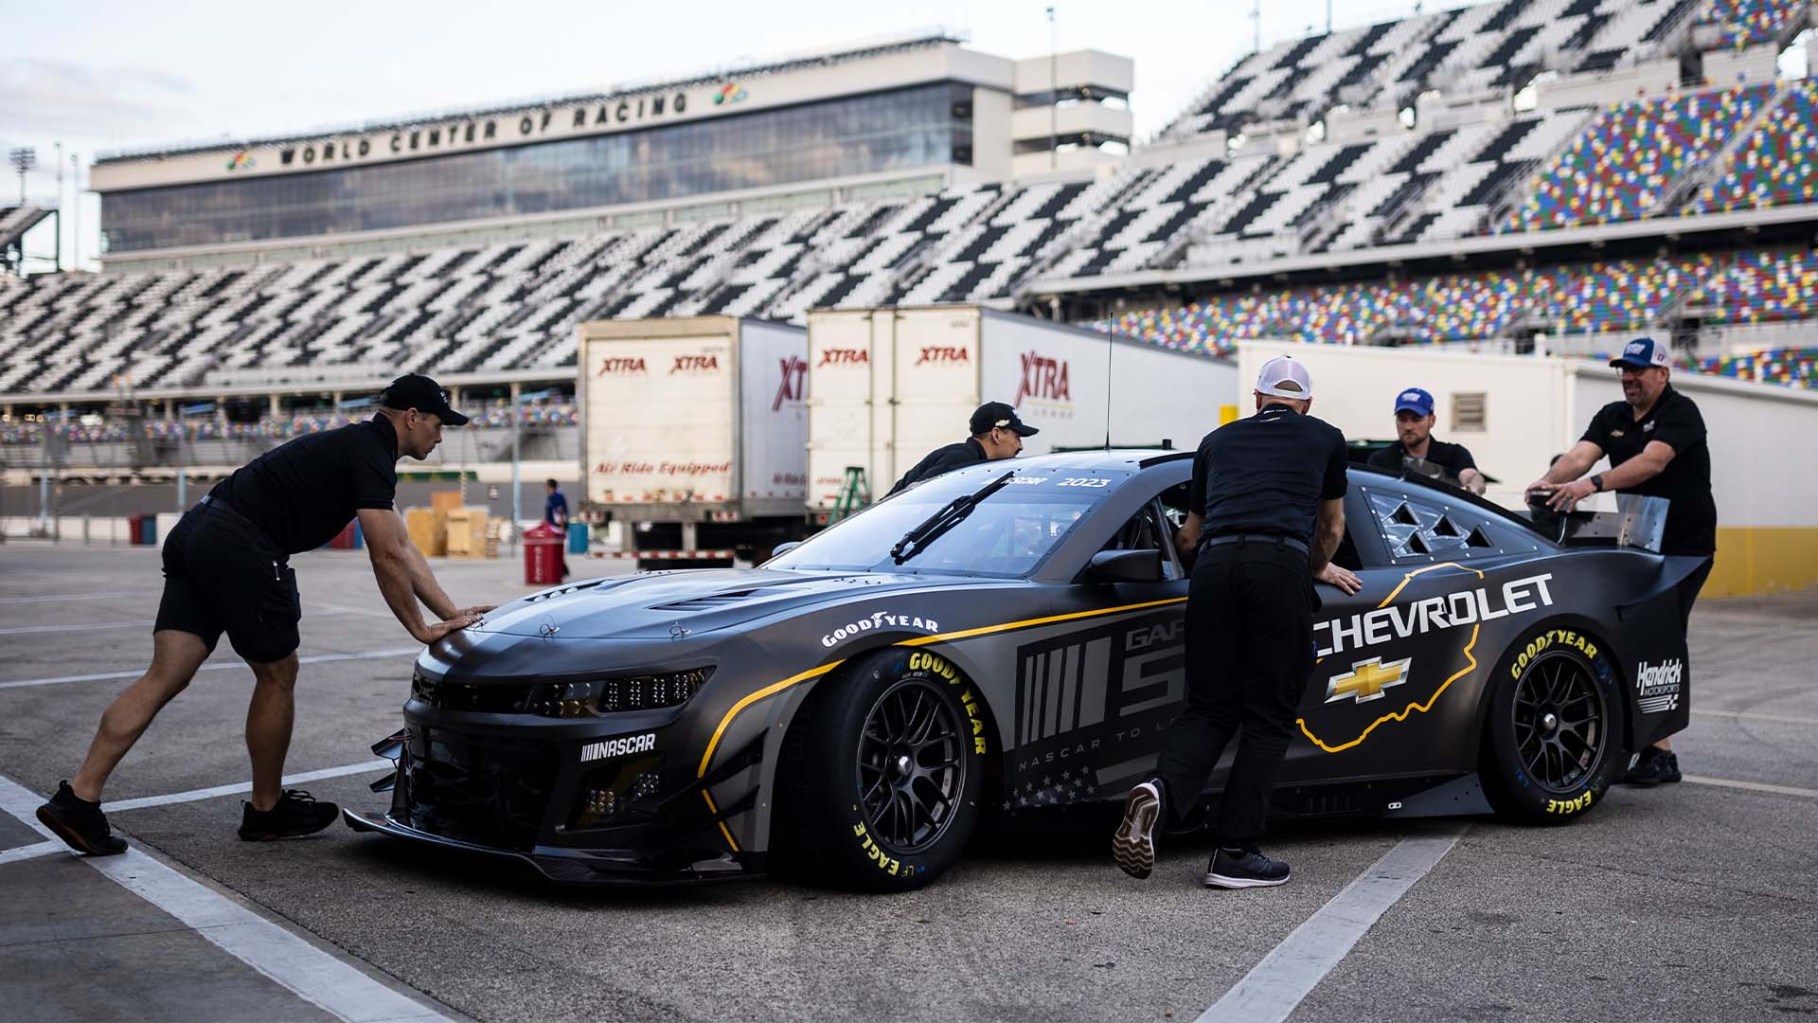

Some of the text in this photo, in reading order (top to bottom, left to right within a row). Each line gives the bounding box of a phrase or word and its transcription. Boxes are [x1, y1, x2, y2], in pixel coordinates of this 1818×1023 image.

[281, 93, 687, 165] WORLD CENTER OF RACING
[598, 357, 646, 377] XTRA
[668, 356, 718, 375] XTRA
[818, 348, 870, 368] XTRA
[915, 347, 968, 366] XTRA
[771, 355, 809, 411] XT
[1016, 351, 1071, 408] XTRA
[595, 462, 732, 478] Air Ride Equipped
[1056, 477, 1112, 488] 2023
[1636, 658, 1683, 696] Hendrick
[598, 733, 656, 759] NASCAR
[1018, 739, 1101, 772] NASCAR
[1116, 728, 1141, 742] TO
[1546, 790, 1592, 814] EAGLE
[853, 821, 900, 876] EAGLE
